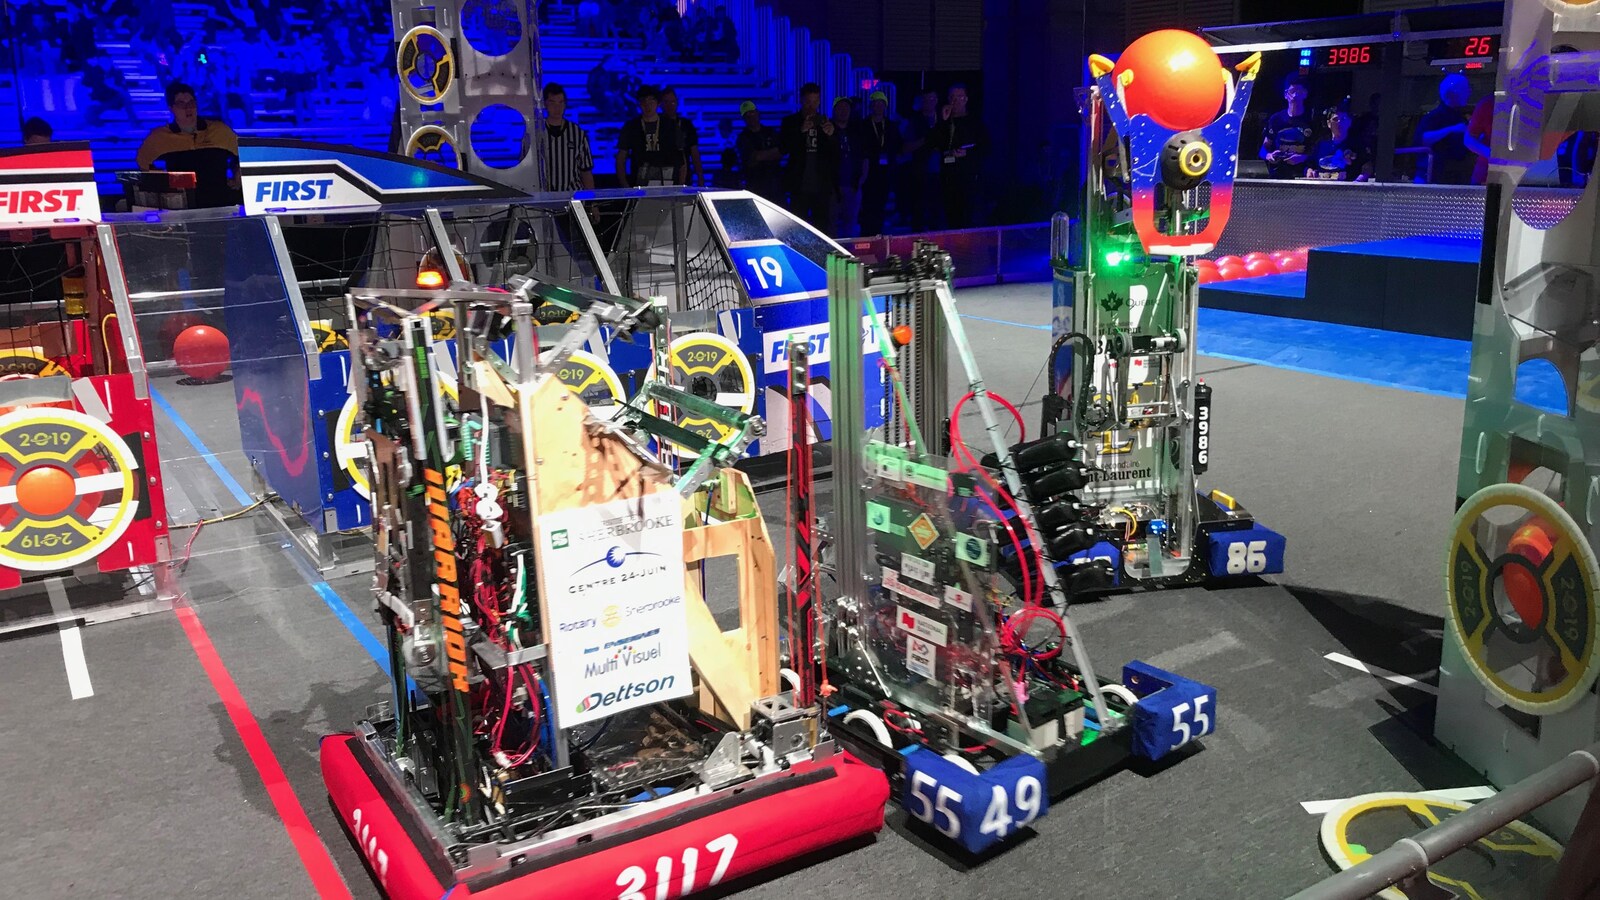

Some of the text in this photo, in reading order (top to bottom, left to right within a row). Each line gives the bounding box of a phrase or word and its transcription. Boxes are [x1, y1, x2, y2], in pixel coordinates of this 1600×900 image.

[1328, 46, 1370, 65] 3986
[1465, 36, 1491, 56] 26
[255, 179, 334, 202] FIRST
[747, 256, 782, 290] 19
[687, 351, 718, 362] 2019
[771, 332, 830, 363] FIST
[559, 368, 585, 380] 019
[19, 432, 71, 447] 2019
[1198, 406, 1209, 465] 3986
[21, 531, 72, 548] 2019
[1226, 540, 1267, 575] 86
[568, 565, 667, 594] CENTRE 24-JUIN
[559, 617, 597, 632] Rotary
[584, 642, 662, 679] Multi Visuel
[587, 675, 675, 711] Dettson
[1170, 694, 1209, 751] 55
[910, 770, 1042, 839] 55 49
[616, 833, 738, 900] 3117
